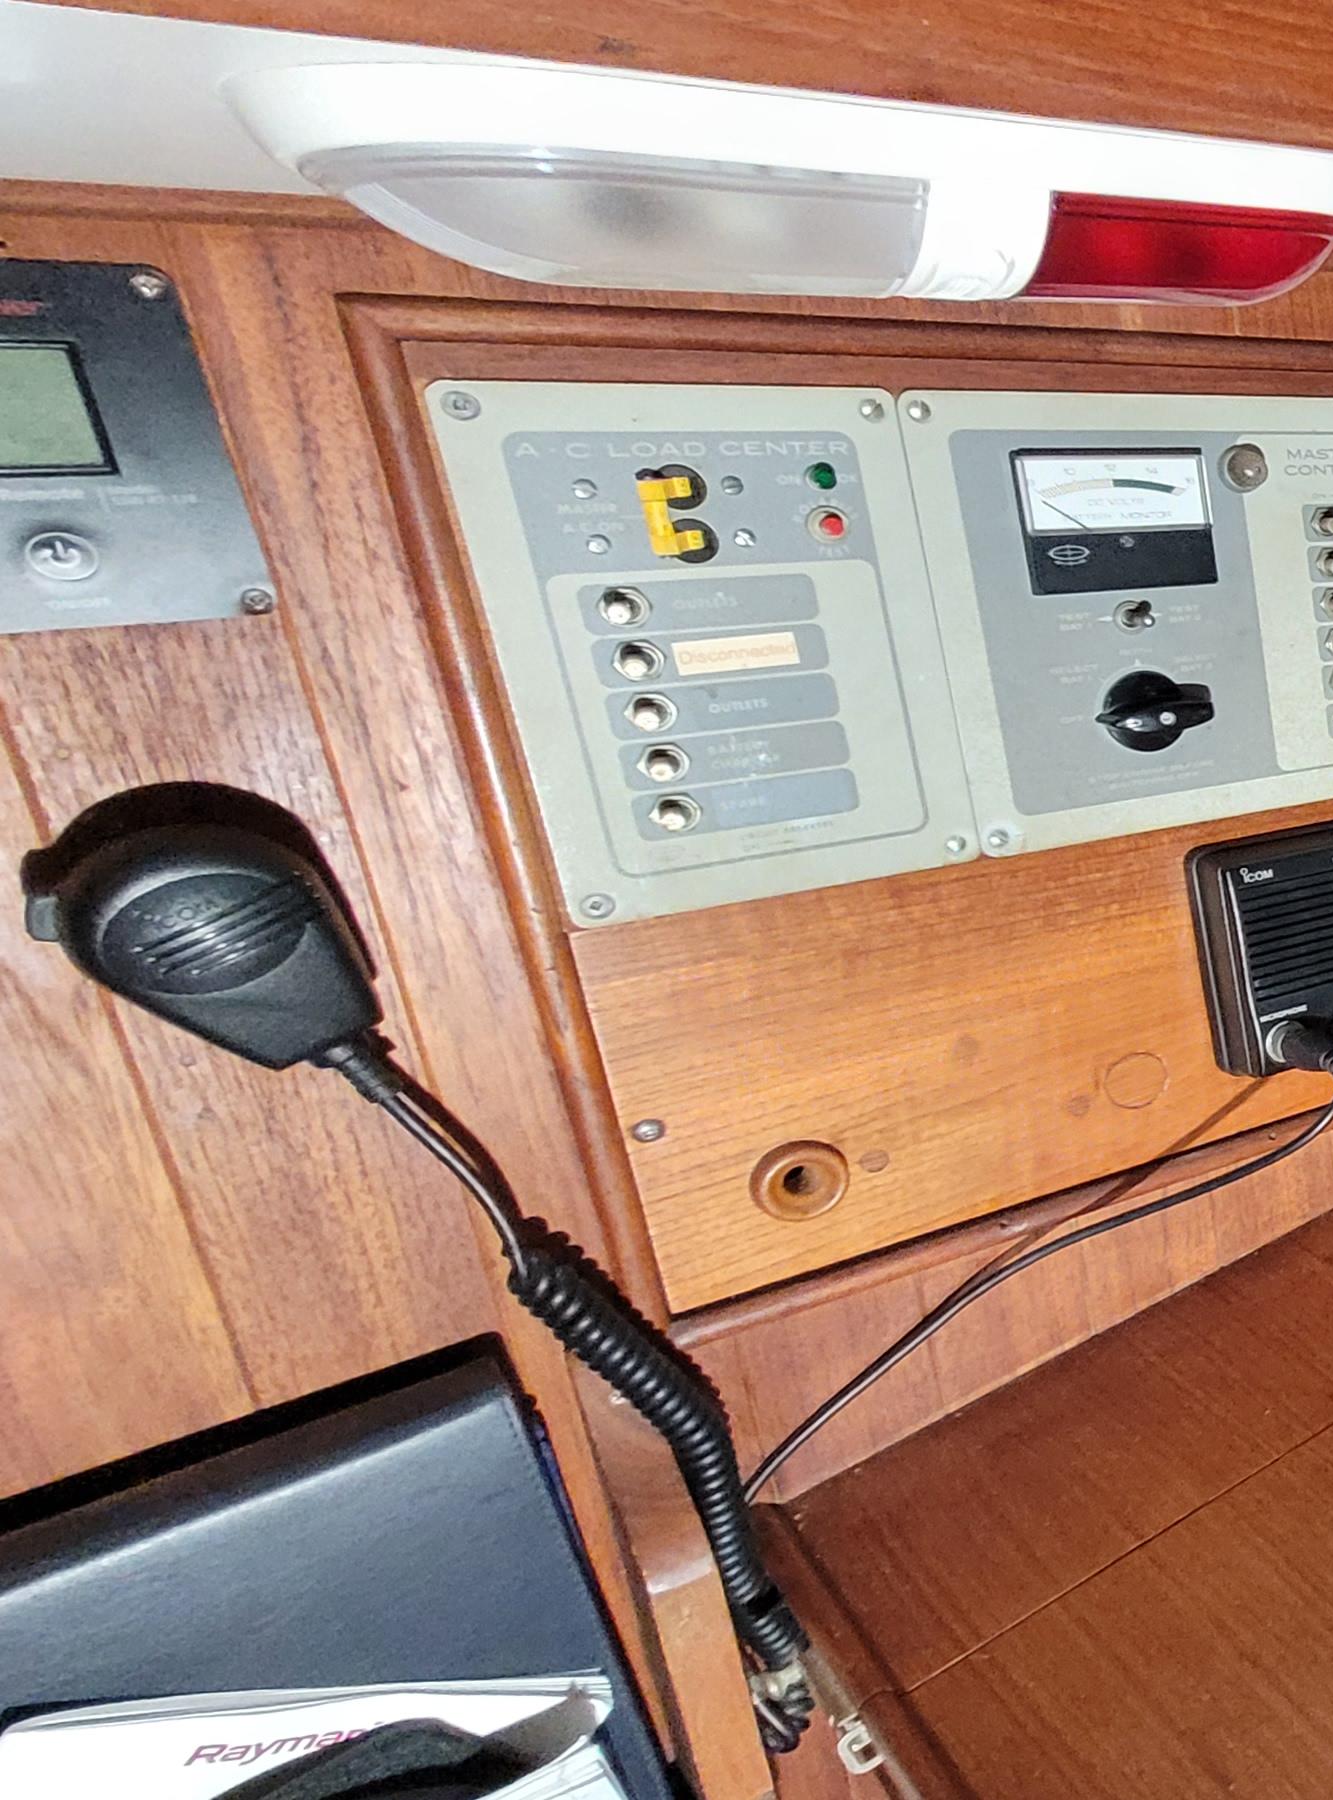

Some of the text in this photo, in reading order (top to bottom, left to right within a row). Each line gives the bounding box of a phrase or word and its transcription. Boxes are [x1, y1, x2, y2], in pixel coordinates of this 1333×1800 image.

[607, 441, 707, 457] LOAD
[718, 440, 850, 457] CENTER
[678, 642, 795, 666] Disconnected
[708, 697, 769, 714] OUTLETS
